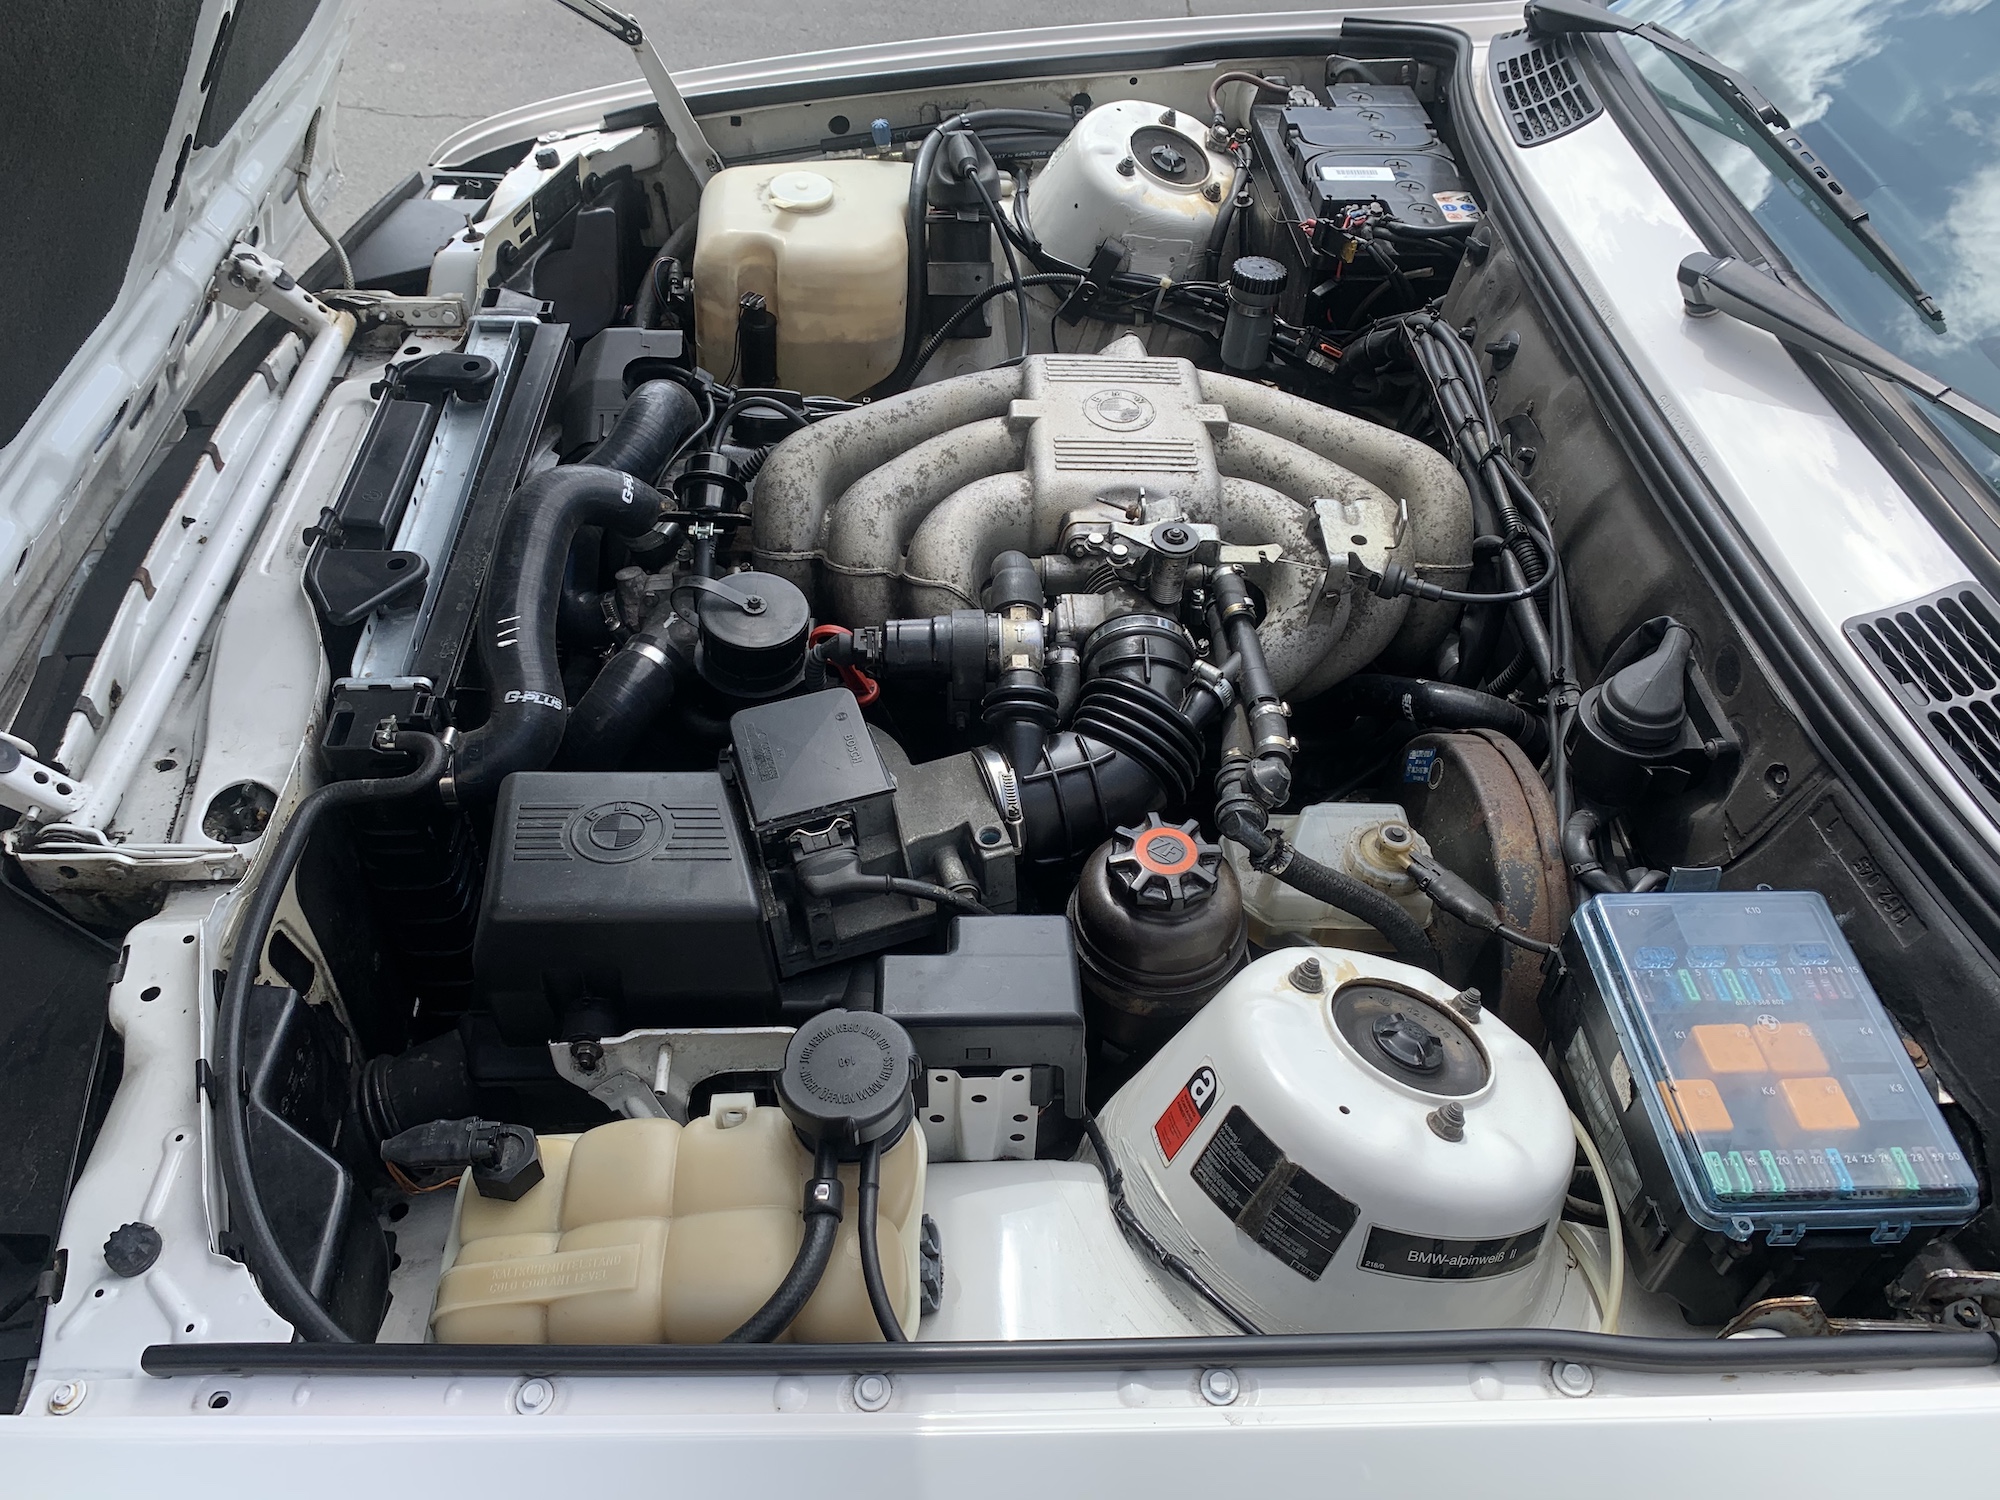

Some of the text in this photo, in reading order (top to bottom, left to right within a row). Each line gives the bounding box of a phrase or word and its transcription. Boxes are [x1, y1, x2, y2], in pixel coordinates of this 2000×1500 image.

[504, 690, 562, 710] G-PLUS
[843, 734, 863, 768] BOSCH
[584, 802, 659, 822] BMW
[1628, 907, 1762, 916] K9 K10
[1648, 970, 1655, 978] 2
[1663, 970, 1671, 978] 3
[1694, 969, 1702, 977] 5
[1711, 969, 1718, 977] 6
[1741, 968, 1748, 976] 8
[1757, 967, 1763, 975] 9
[1771, 967, 1781, 975] 10
[1787, 967, 1797, 975] 11
[1802, 967, 1813, 975] 12
[1817, 967, 1829, 975] 13
[1848, 966, 1859, 974] 15
[1674, 1031, 1686, 1039] K1
[1859, 1027, 1873, 1035] K4
[800, 1023, 890, 1064] DO NOT OPEN WHEN HOT
[800, 1056, 894, 1104] NICHT ÖFFNEN WENN HEISS
[1190, 1069, 1215, 1110] a
[1761, 1086, 1776, 1095] K6
[1825, 1085, 1838, 1094] K7
[1889, 1084, 1904, 1092] K8
[1723, 1158, 1734, 1166] 17
[1745, 1157, 1757, 1165] 18
[1776, 1157, 1790, 1165] 20
[1795, 1156, 1806, 1164] 21
[1811, 1156, 1824, 1164] 22
[1844, 1155, 1858, 1163] 24
[1861, 1154, 1875, 1163] 25
[1910, 1153, 1924, 1162] 28
[1932, 1152, 1944, 1161] 29
[1947, 1152, 1960, 1160] 30
[1407, 1249, 1505, 1268] BMW-alpinweiß
[490, 1269, 608, 1294] COLD COOLANT LEVEL
